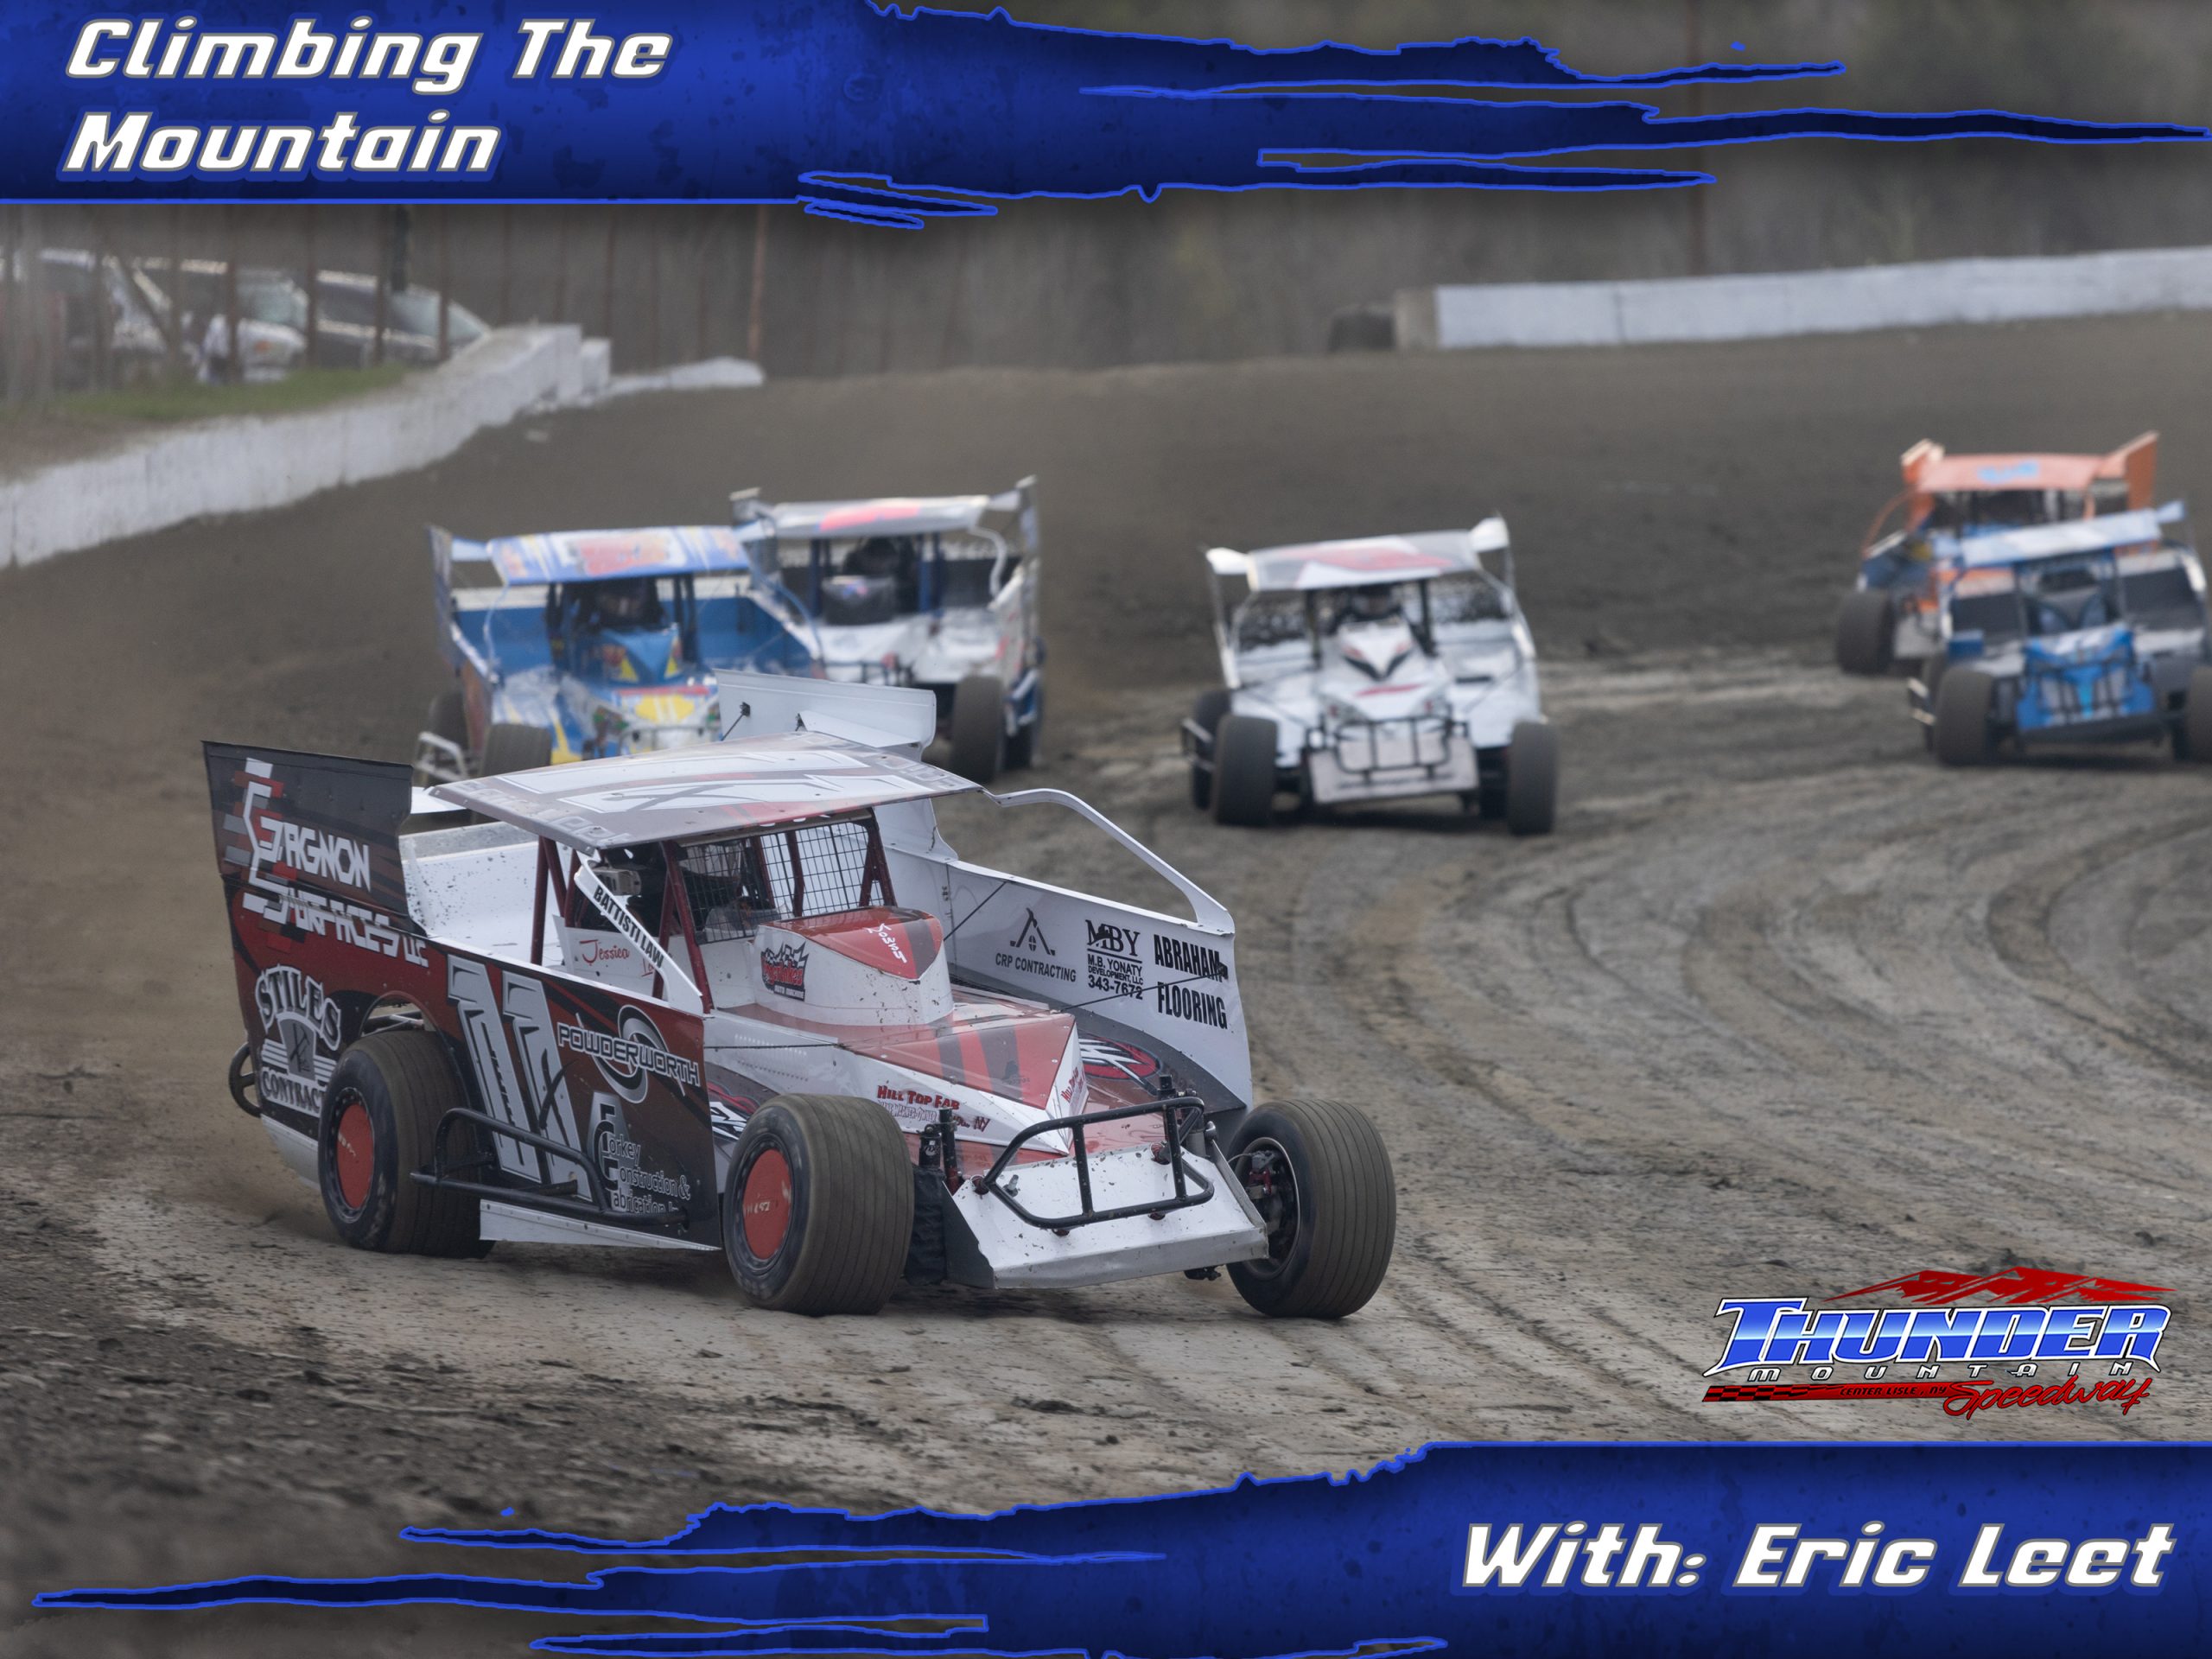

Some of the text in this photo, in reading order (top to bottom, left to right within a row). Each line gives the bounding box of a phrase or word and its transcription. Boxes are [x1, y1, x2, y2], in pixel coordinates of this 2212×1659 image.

[593, 885, 641, 944] BATTISTI
[639, 934, 664, 968] LAW
[579, 939, 630, 966] Jessica
[1088, 954, 1142, 977] M.B. YONATY
[995, 953, 1077, 982] CRP CONTRACTING
[1088, 966, 1144, 985] DEVELOPMENT, LLC
[1088, 975, 1143, 1000] 343-7672
[255, 963, 340, 1051] STILES
[1158, 982, 1228, 1029] FLOORING
[557, 1022, 701, 1087] POWDERWORTH
[262, 1069, 327, 1116] CONTRAC
[877, 1085, 960, 1110] HILL TOP FAB
